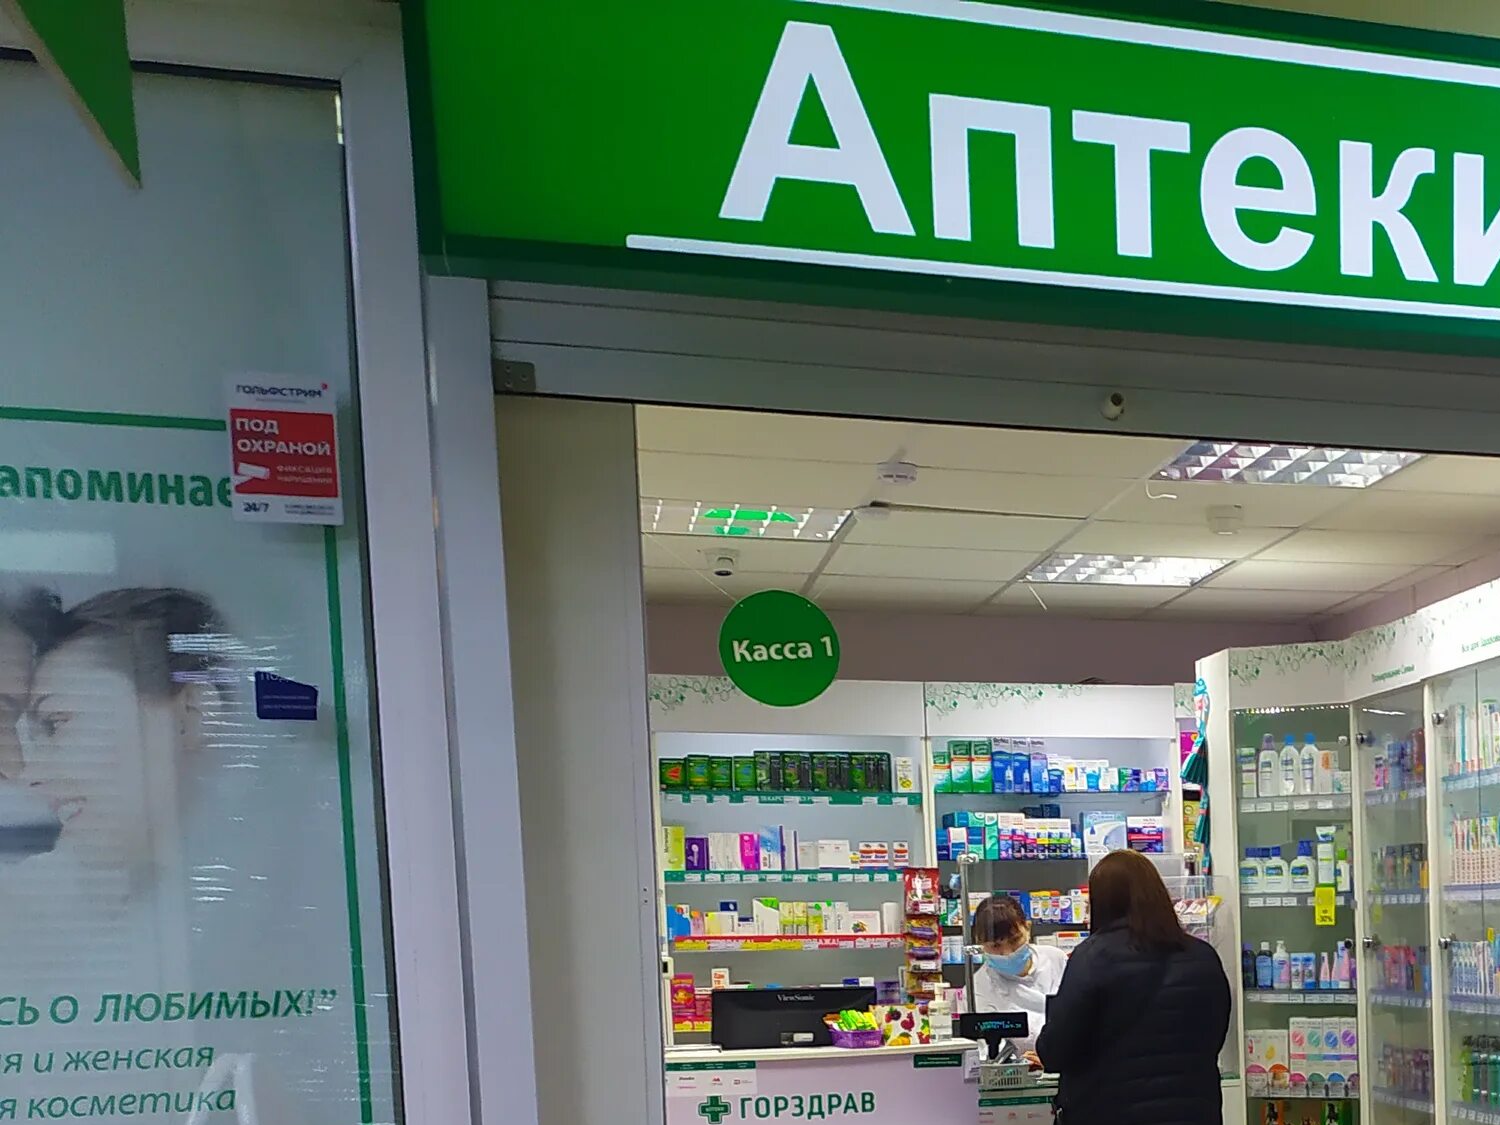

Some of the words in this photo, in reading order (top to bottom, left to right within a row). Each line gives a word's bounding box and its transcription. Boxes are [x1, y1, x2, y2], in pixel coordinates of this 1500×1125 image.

[235, 384, 322, 398] ГОЛЬФСТРИМ
[235, 417, 279, 434] ПОД
[237, 438, 331, 456] ОХРАНОЙ
[243, 502, 269, 513] 24/7
[732, 639, 813, 662] Касса
[820, 635, 833, 657] 1
[50, 995, 79, 1024] О
[35, 1053, 53, 1073] и
[64, 1045, 215, 1073] женская
[28, 1088, 237, 1120] косметика
[739, 1091, 876, 1121] ГОРЗДРАВ
